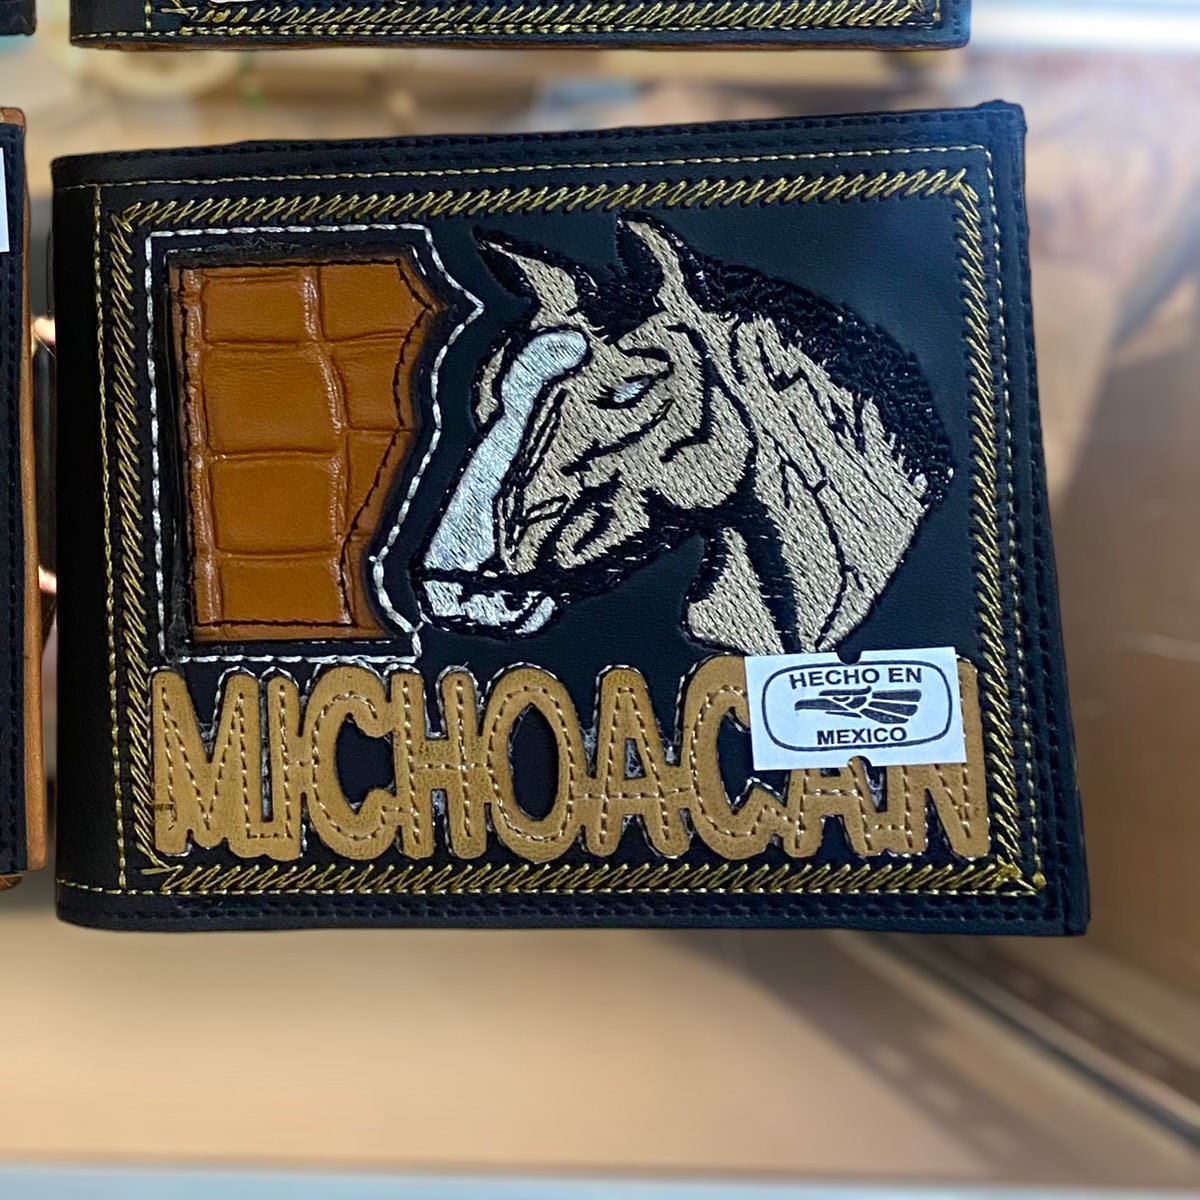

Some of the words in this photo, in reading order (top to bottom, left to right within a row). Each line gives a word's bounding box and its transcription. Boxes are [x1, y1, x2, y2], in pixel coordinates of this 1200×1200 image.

[789, 668, 880, 690] HECHO
[888, 667, 922, 684] EN
[816, 727, 907, 745] MEXICO
